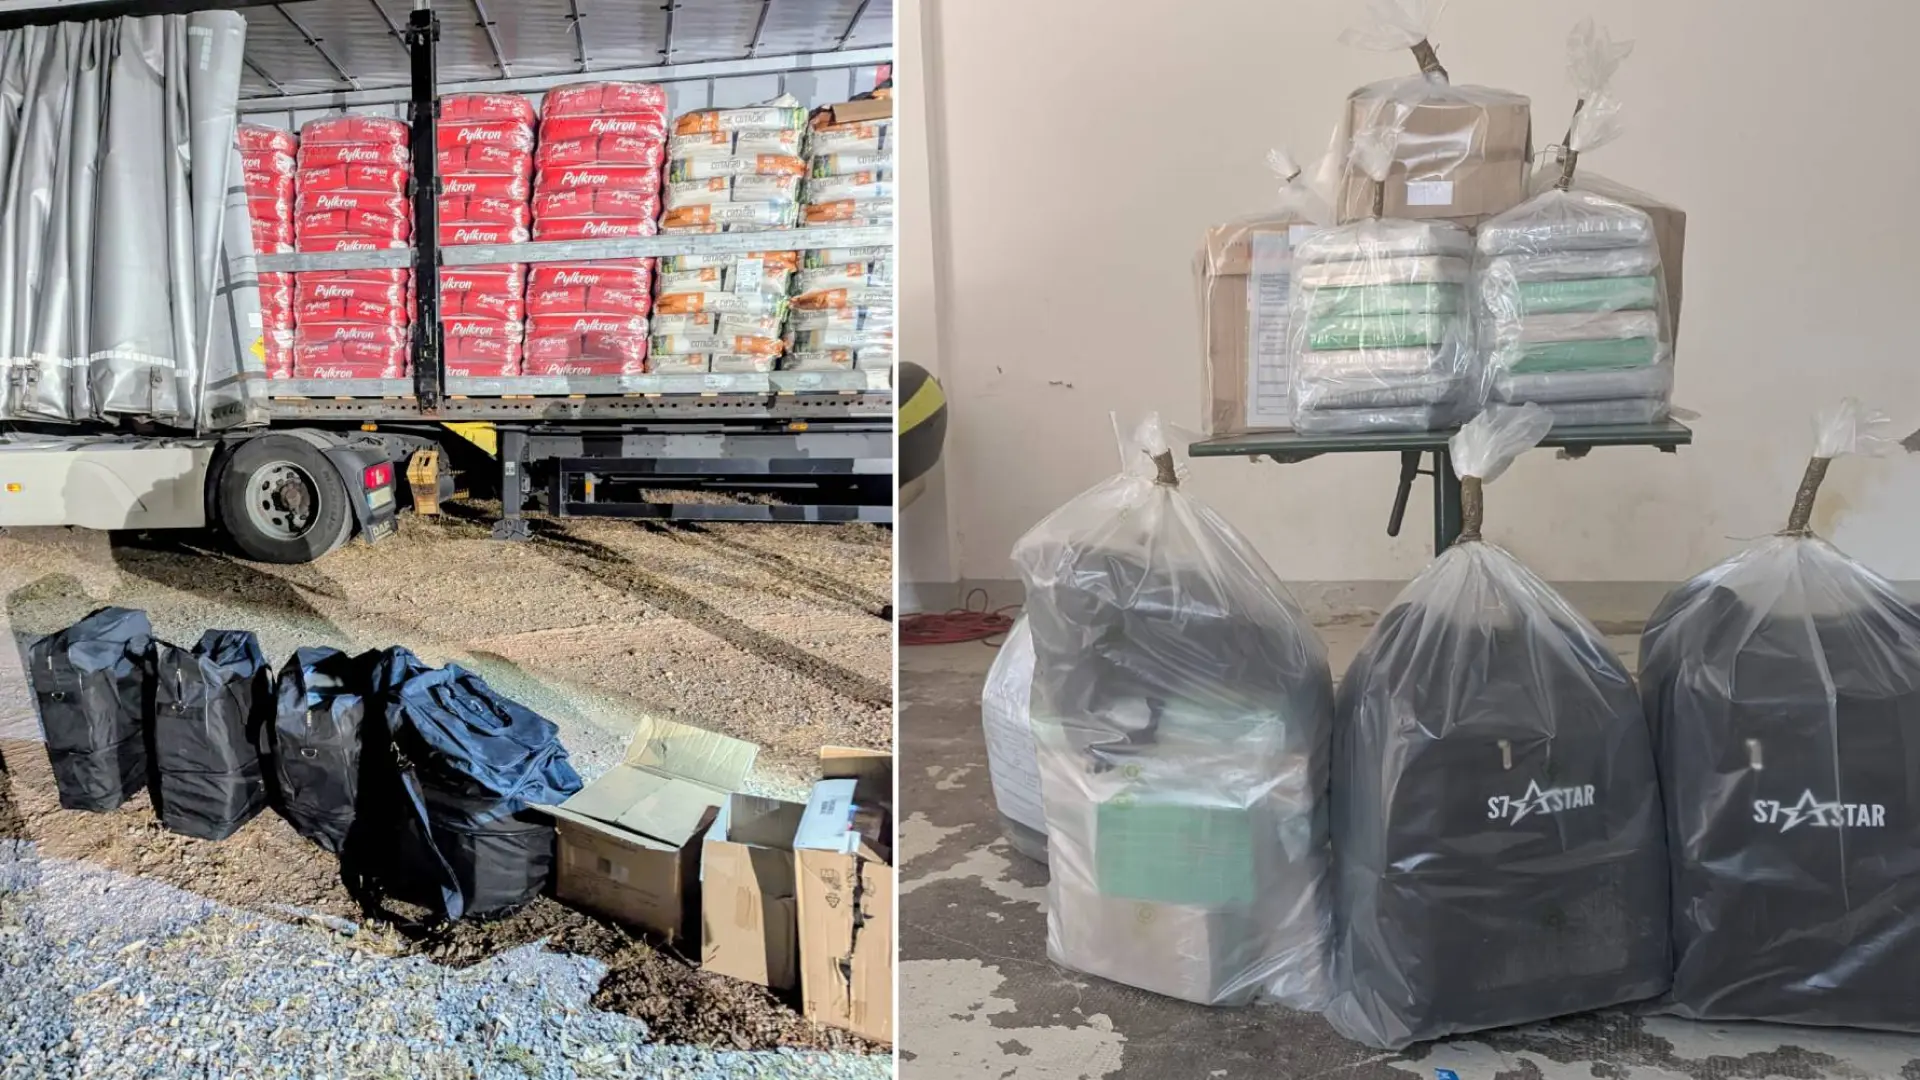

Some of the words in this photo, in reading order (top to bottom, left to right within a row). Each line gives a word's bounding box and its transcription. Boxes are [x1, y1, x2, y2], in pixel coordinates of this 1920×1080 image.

[589, 118, 637, 135] Pylkron
[457, 127, 502, 144] Pylkron
[337, 147, 379, 162] Pylkron
[561, 171, 608, 186] Pylkron
[442, 179, 477, 196] ylkron
[316, 194, 357, 209] Pylkron
[454, 228, 498, 243] Pylkron
[582, 221, 628, 236] Pylkron
[335, 239, 376, 251] Pylkron
[440, 276, 473, 291] ylkron
[554, 271, 599, 286] Pylkron
[314, 284, 354, 298] Pylkron
[451, 321, 493, 337] Pylkron
[573, 318, 619, 333] Pylkron
[334, 327, 374, 341] Pylkron
[313, 366, 353, 378] Pylkron
[547, 362, 592, 376] Pylkron
[1487, 795, 1510, 819] S7
[1551, 784, 1595, 812] STAR
[1752, 799, 1780, 823] S7
[1831, 803, 1886, 827] STAR
